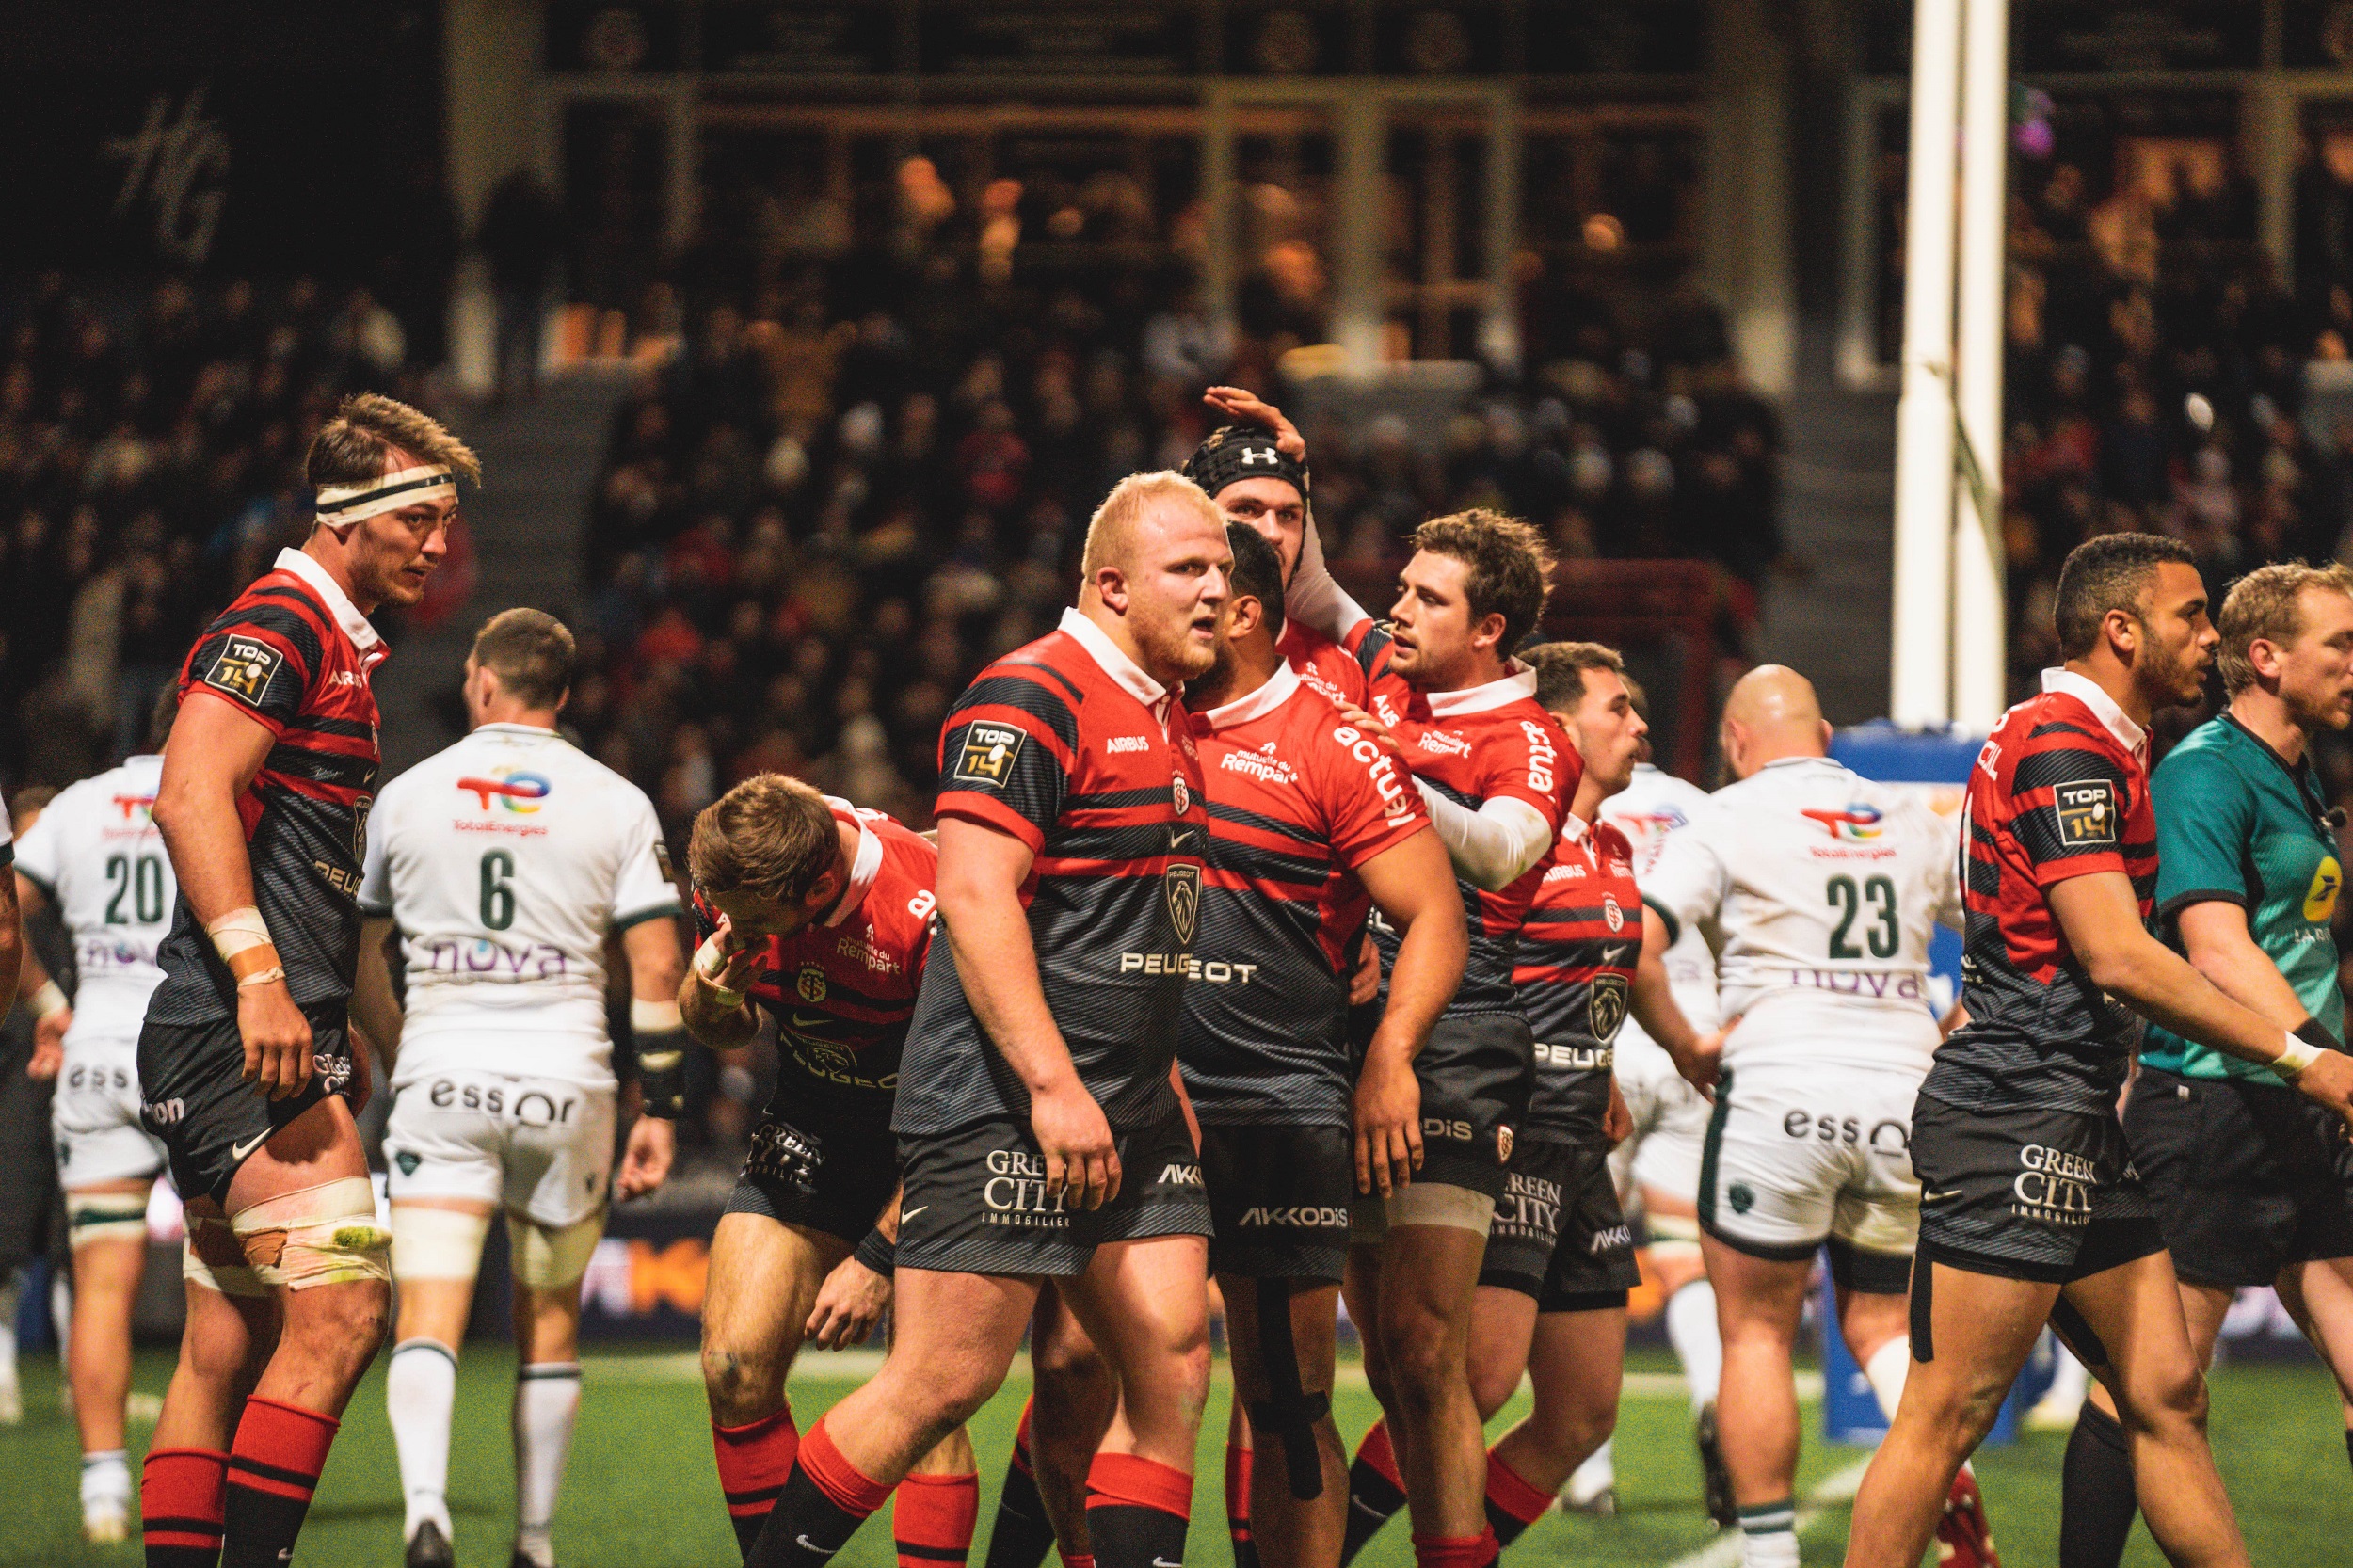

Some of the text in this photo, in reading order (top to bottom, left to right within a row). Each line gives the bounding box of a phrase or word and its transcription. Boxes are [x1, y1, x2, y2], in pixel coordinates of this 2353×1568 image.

[233, 643, 272, 665] TOP
[219, 665, 259, 695] 14
[975, 728, 1016, 745] TOP
[1107, 736, 1149, 753] AIRBUS
[968, 754, 1004, 777] 14
[1220, 753, 1299, 784] Rempart
[1237, 749, 1291, 772] mutuelle du
[1333, 726, 1416, 828] actual
[2062, 789, 2107, 805] TOP
[2071, 816, 2106, 838] 14
[105, 852, 165, 925] 20
[480, 847, 515, 931] 6
[1826, 873, 1901, 959] 23
[836, 936, 901, 975] Rempart
[879, 950, 890, 961] du
[1120, 952, 1257, 984] PEUGEOT
[430, 1079, 576, 1128] essor
[2020, 1144, 2099, 1185] GREEN
[1505, 1172, 1561, 1207] REEN
[2014, 1171, 2093, 1212] CITY
[982, 1211, 1070, 1227] IMMOBILIER
